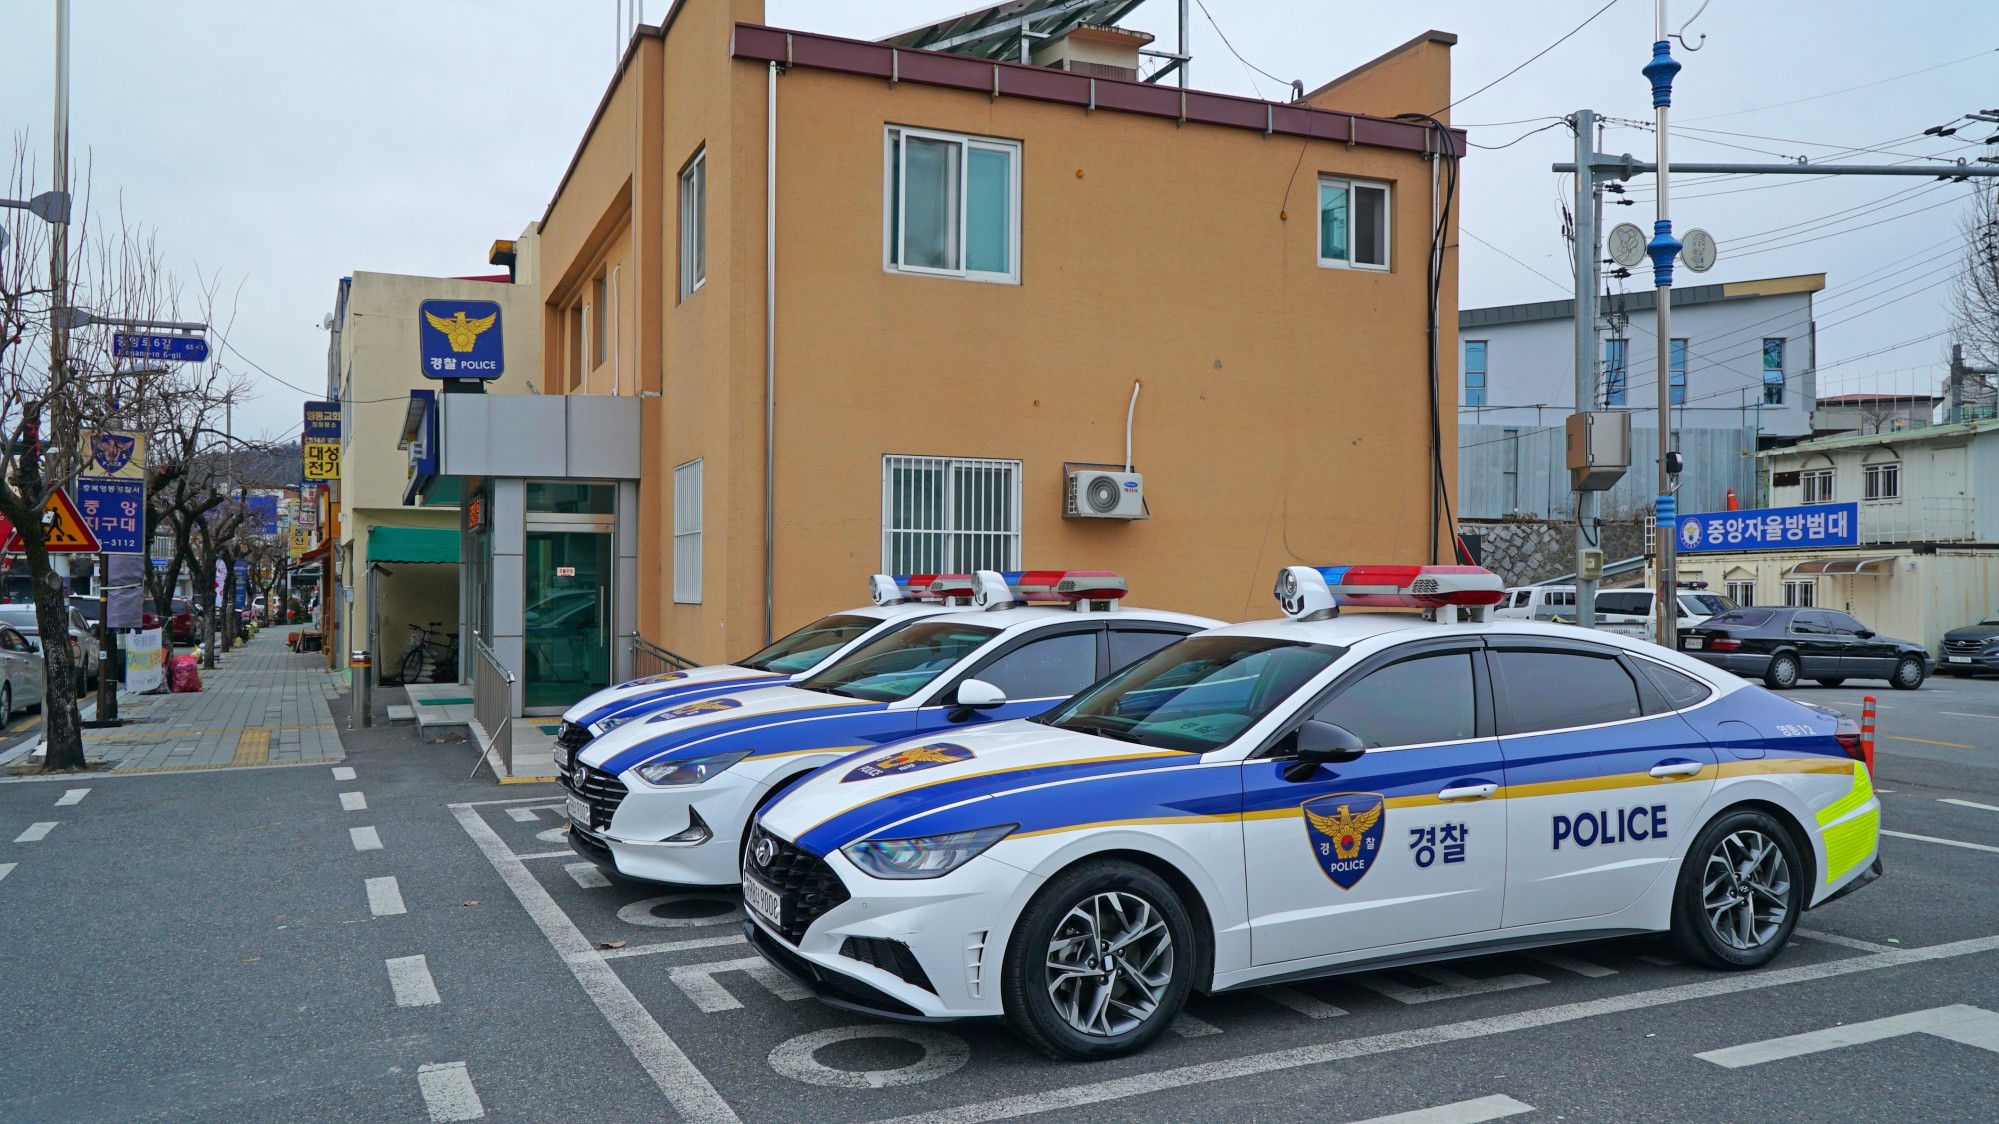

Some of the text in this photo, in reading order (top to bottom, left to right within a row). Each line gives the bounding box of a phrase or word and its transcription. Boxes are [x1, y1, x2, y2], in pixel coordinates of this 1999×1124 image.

[430, 357, 496, 370] 경찰 POLICE
[309, 446, 339, 461] 대성
[309, 461, 339, 476] 전기
[85, 516, 136, 532] 지구대
[1706, 510, 1848, 545] 중앙자율방범대
[1553, 804, 1668, 850] POLICE
[1320, 837, 1376, 856] 경 찰
[1410, 823, 1468, 868] 경찰
[1331, 859, 1365, 873] POLICE
